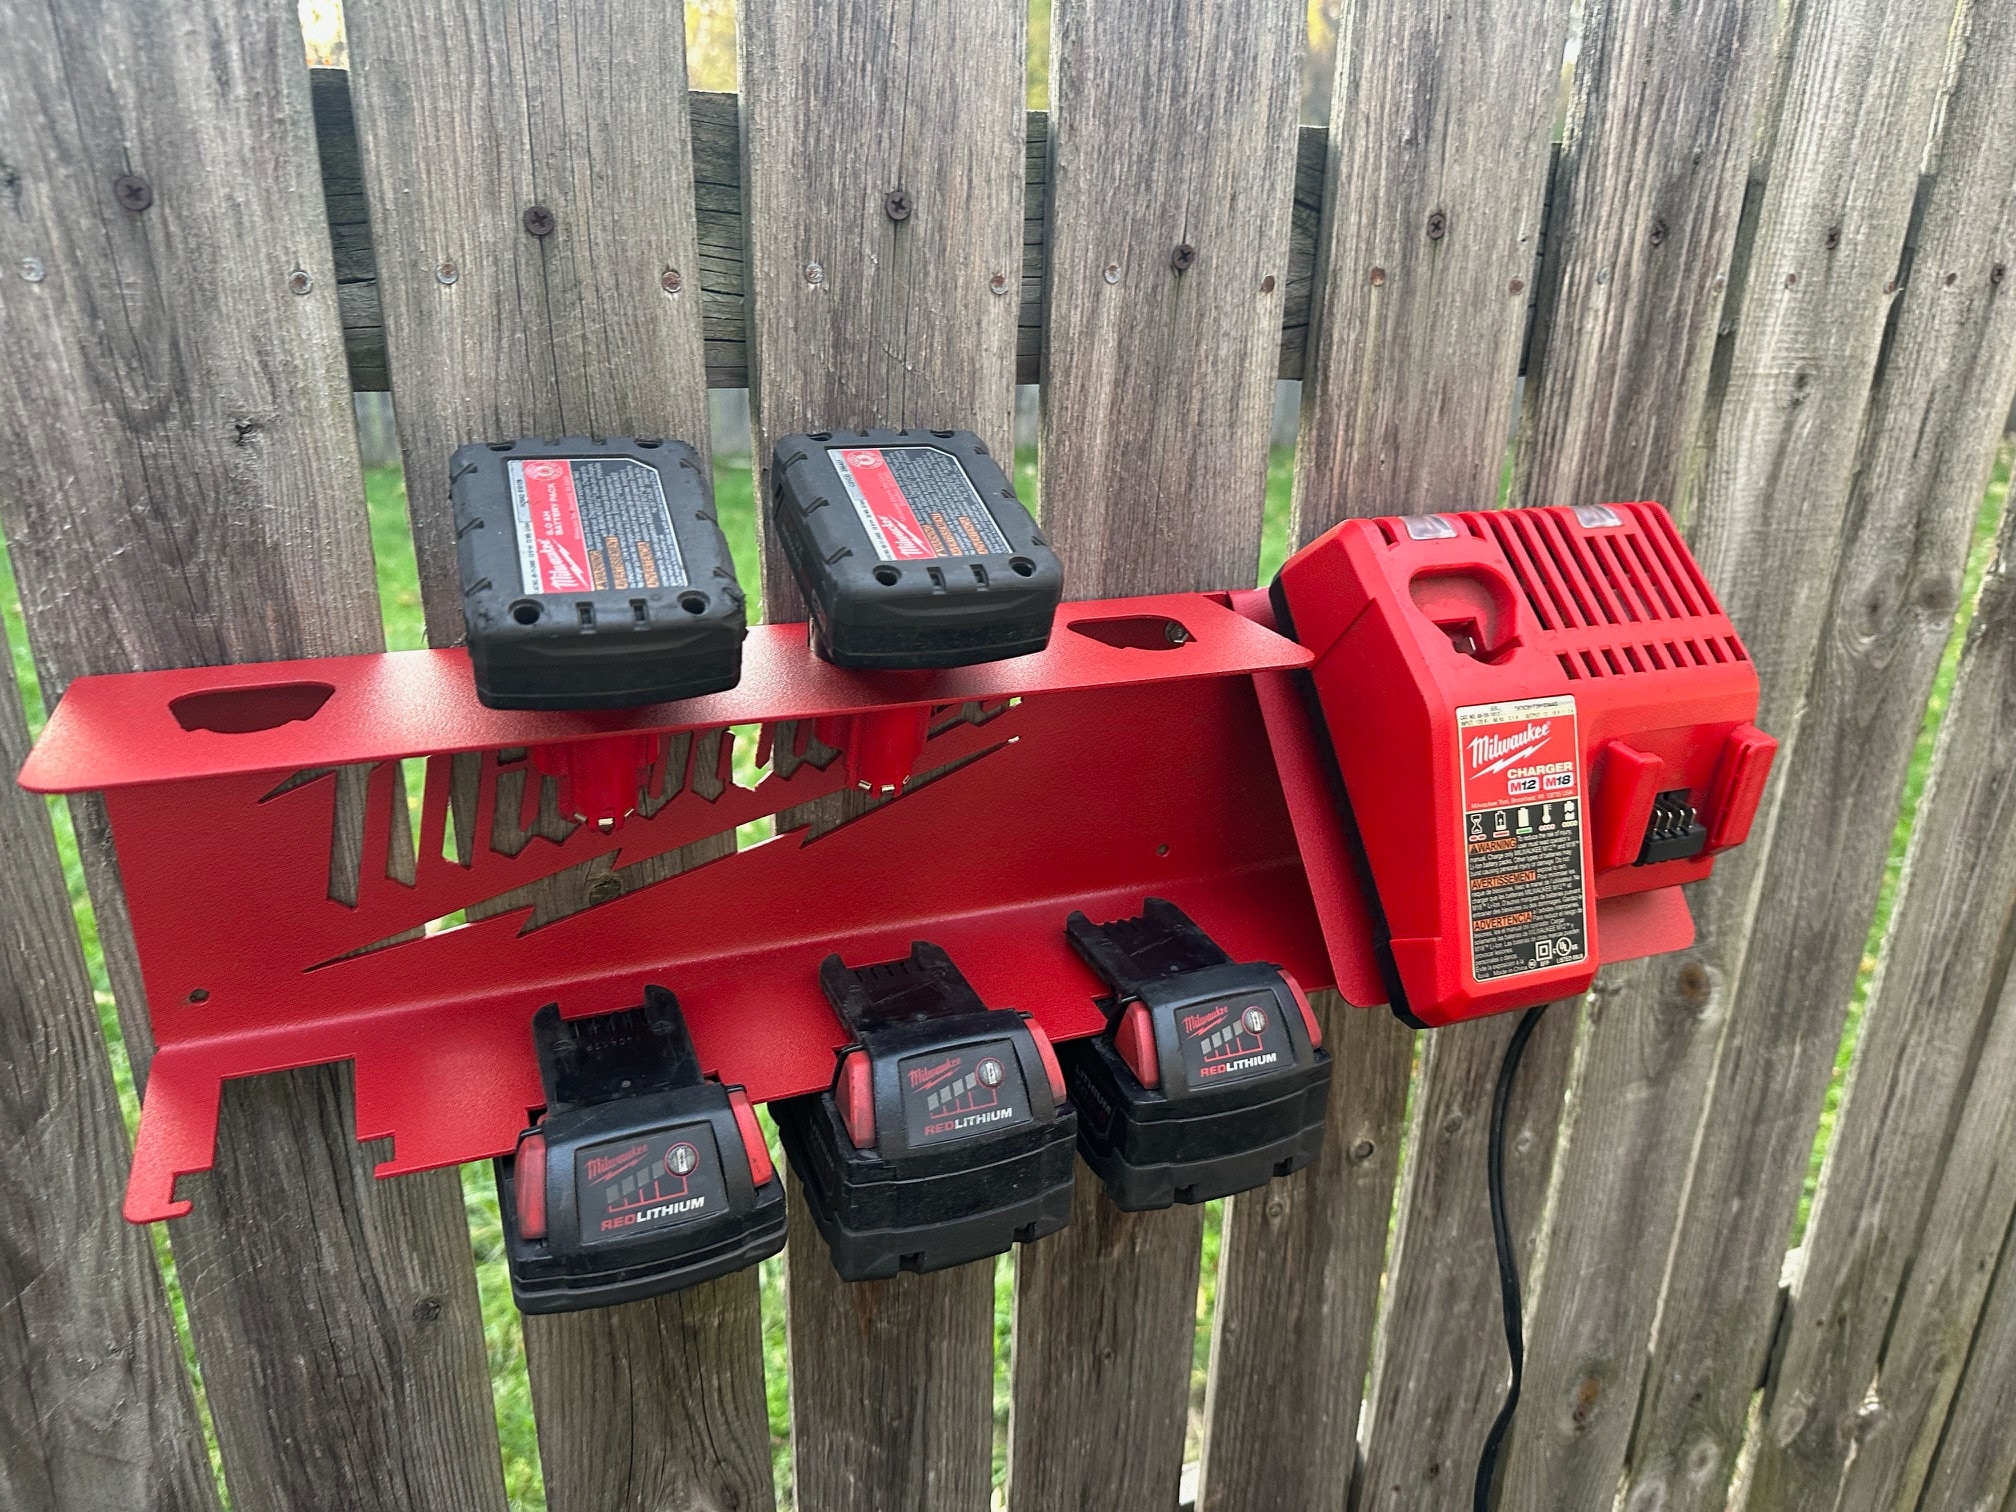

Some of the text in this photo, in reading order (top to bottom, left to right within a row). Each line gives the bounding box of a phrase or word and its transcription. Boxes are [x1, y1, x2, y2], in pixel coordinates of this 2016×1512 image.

[547, 483, 563, 536] BATTERY PACK
[1467, 722, 1549, 768] Milwaukee
[1507, 762, 1573, 779] CHARGER
[1510, 774, 1571, 793] M12 M18
[1478, 838, 1516, 852] WARNING
[1472, 871, 1535, 890] AVERTISSEMENT
[1474, 912, 1532, 930] ADVERTENCIA
[1182, 1006, 1228, 1033] Milwaukee
[908, 1057, 962, 1088] Milwaukee
[1200, 1052, 1278, 1078] REDLITHIUM
[924, 1108, 1012, 1136] REDLITHIUM
[585, 1144, 648, 1180] Milwaukee
[600, 1196, 705, 1231] REDLITHIUM
